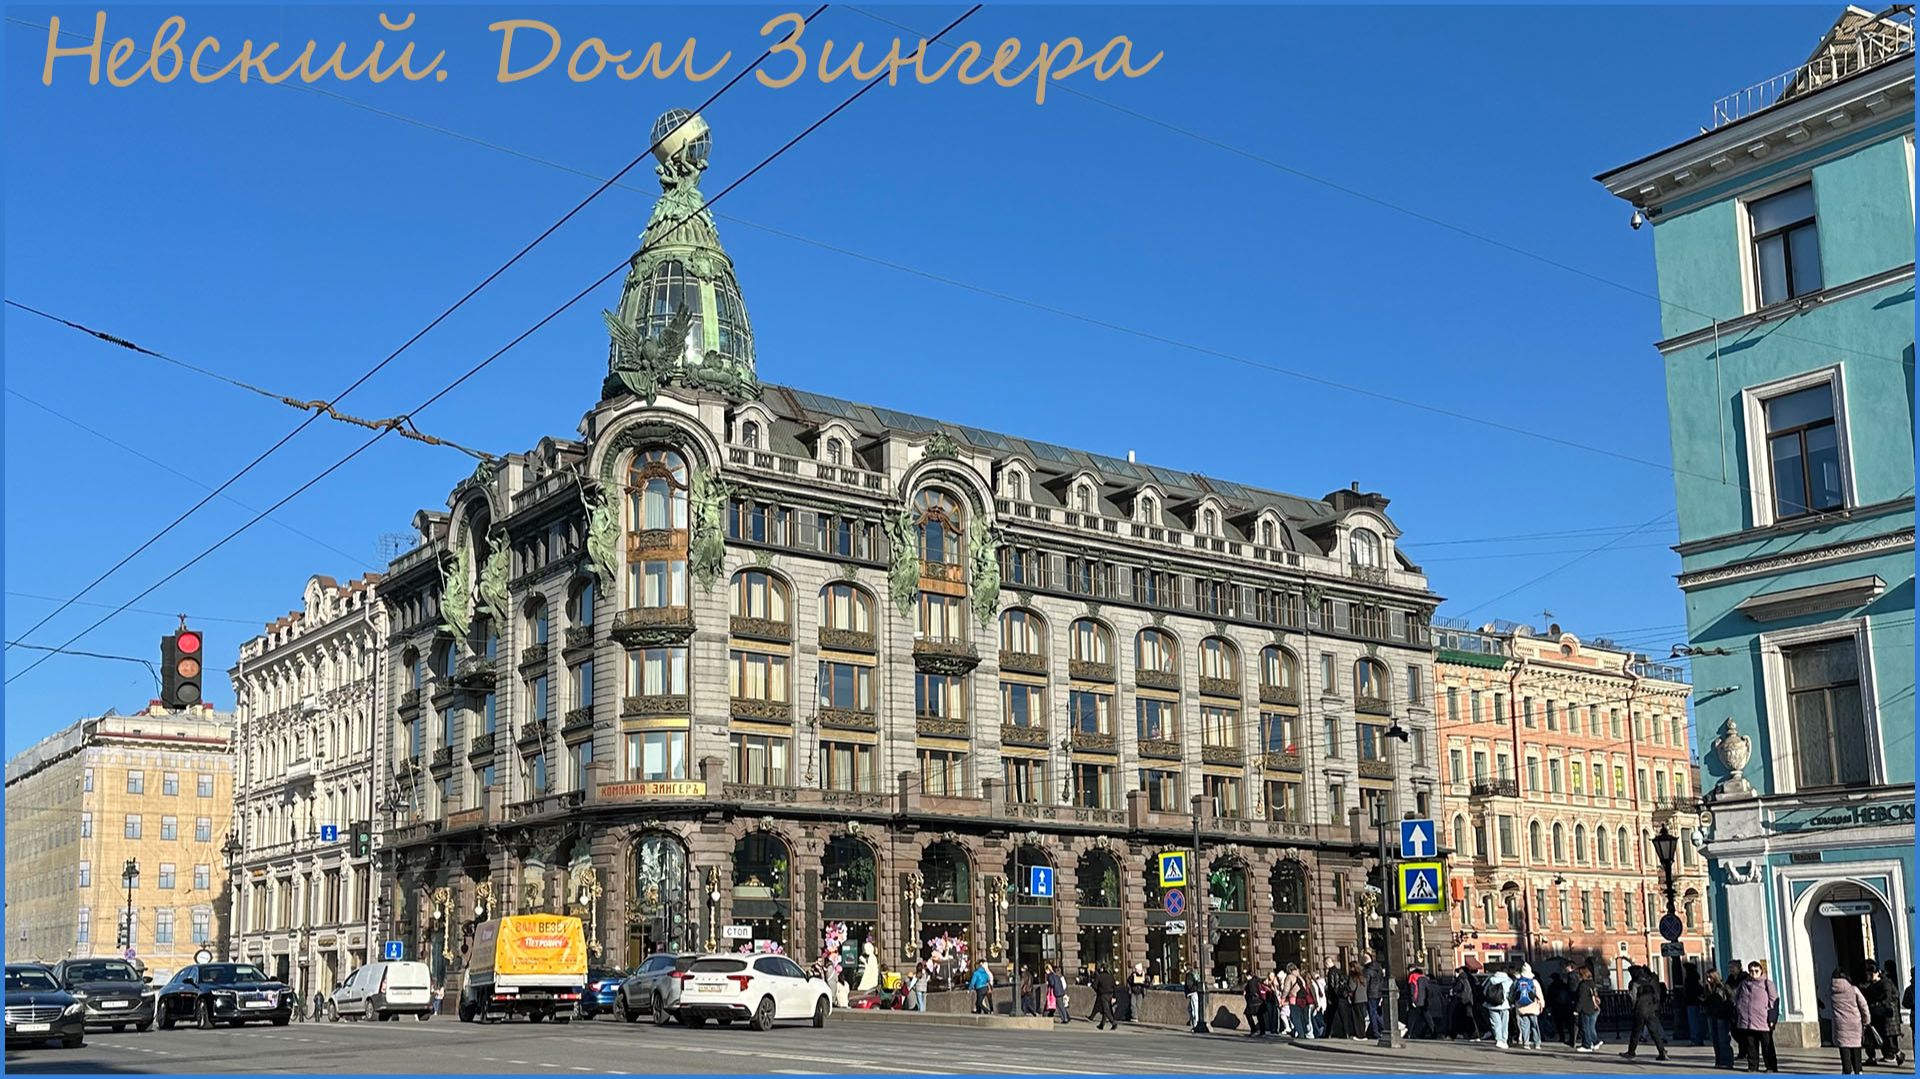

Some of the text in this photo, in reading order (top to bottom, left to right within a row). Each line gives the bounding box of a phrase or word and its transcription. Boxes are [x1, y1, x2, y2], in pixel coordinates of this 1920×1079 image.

[601, 783, 699, 797] КОМПАНІЯ ЗИНГЕРЪ
[1851, 803, 1915, 824] НЕВСК
[726, 927, 748, 936] СТОП
